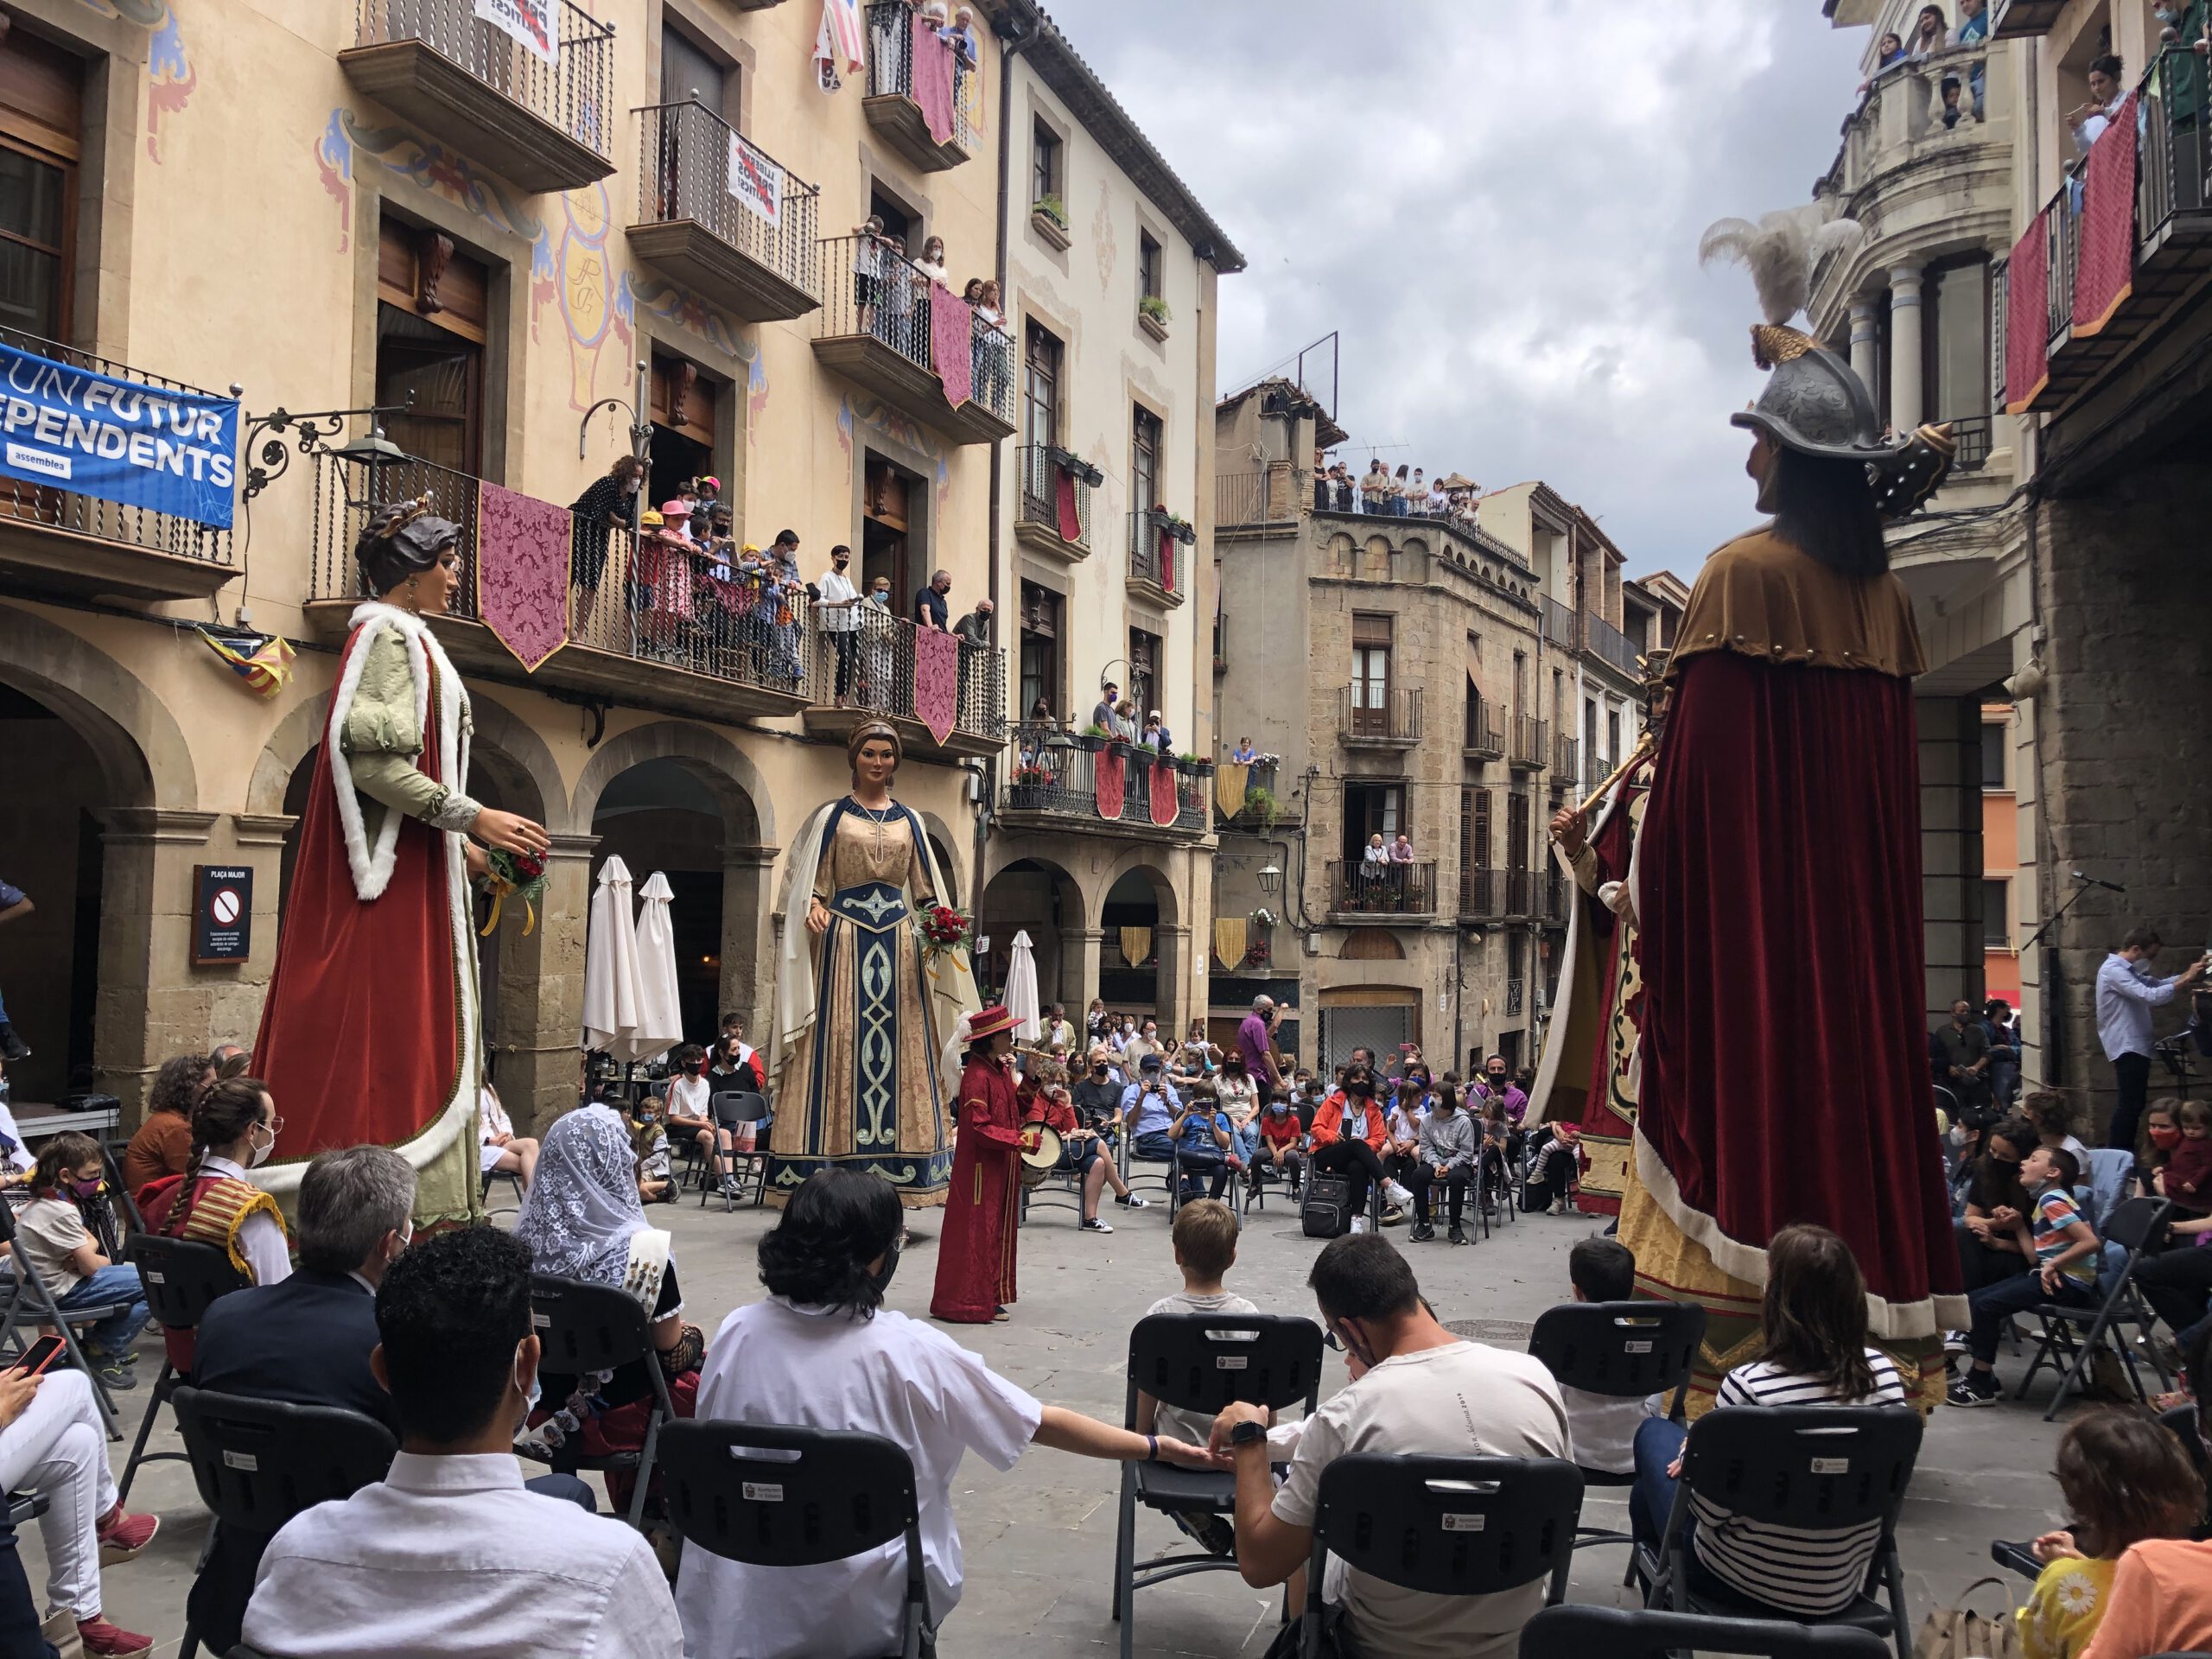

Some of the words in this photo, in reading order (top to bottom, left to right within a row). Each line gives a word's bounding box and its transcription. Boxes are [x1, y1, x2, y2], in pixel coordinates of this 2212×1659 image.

[9, 357, 80, 406] UN
[83, 381, 223, 445] FUTUR
[0, 393, 233, 488] PENDENTS
[15, 451, 65, 471] assemblea
[211, 871, 227, 880] PLAÇA
[1457, 1393, 1467, 1408] 2019
